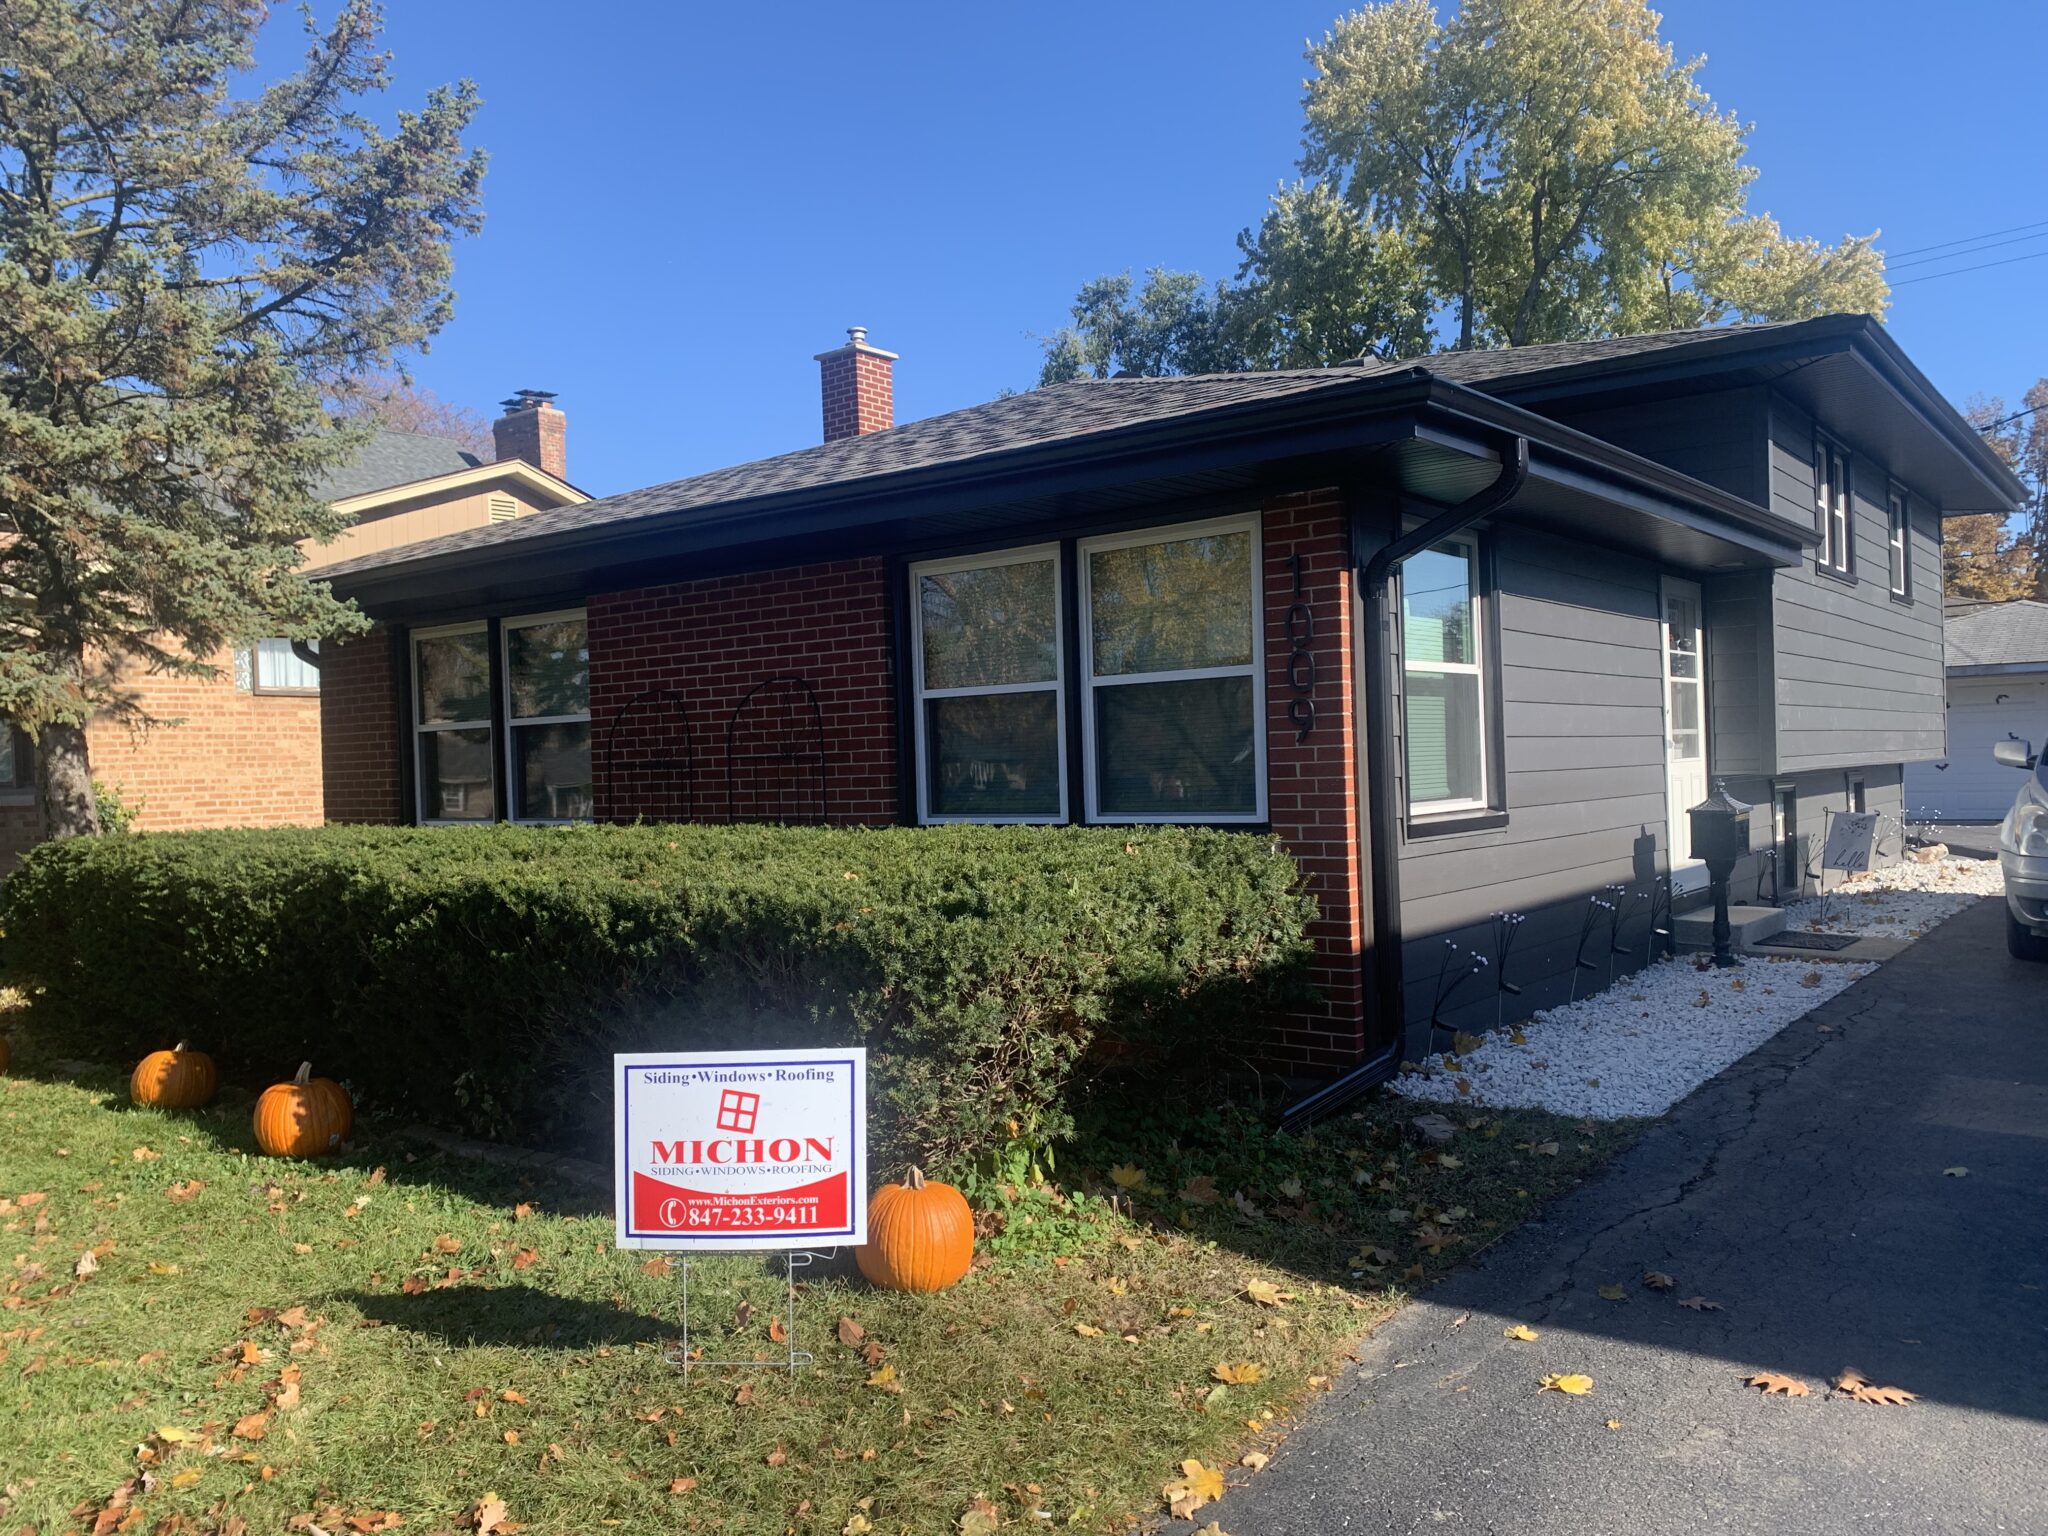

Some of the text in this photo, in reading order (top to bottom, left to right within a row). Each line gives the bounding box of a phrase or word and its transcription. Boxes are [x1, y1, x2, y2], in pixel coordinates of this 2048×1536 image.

[1286, 554, 1315, 743] 1009
[1833, 848, 1865, 868] hello
[650, 1137, 833, 1164] MICHON
[688, 1195, 819, 1206] www.MichonExteriors.com
[688, 1207, 818, 1225] 847-233-9411
